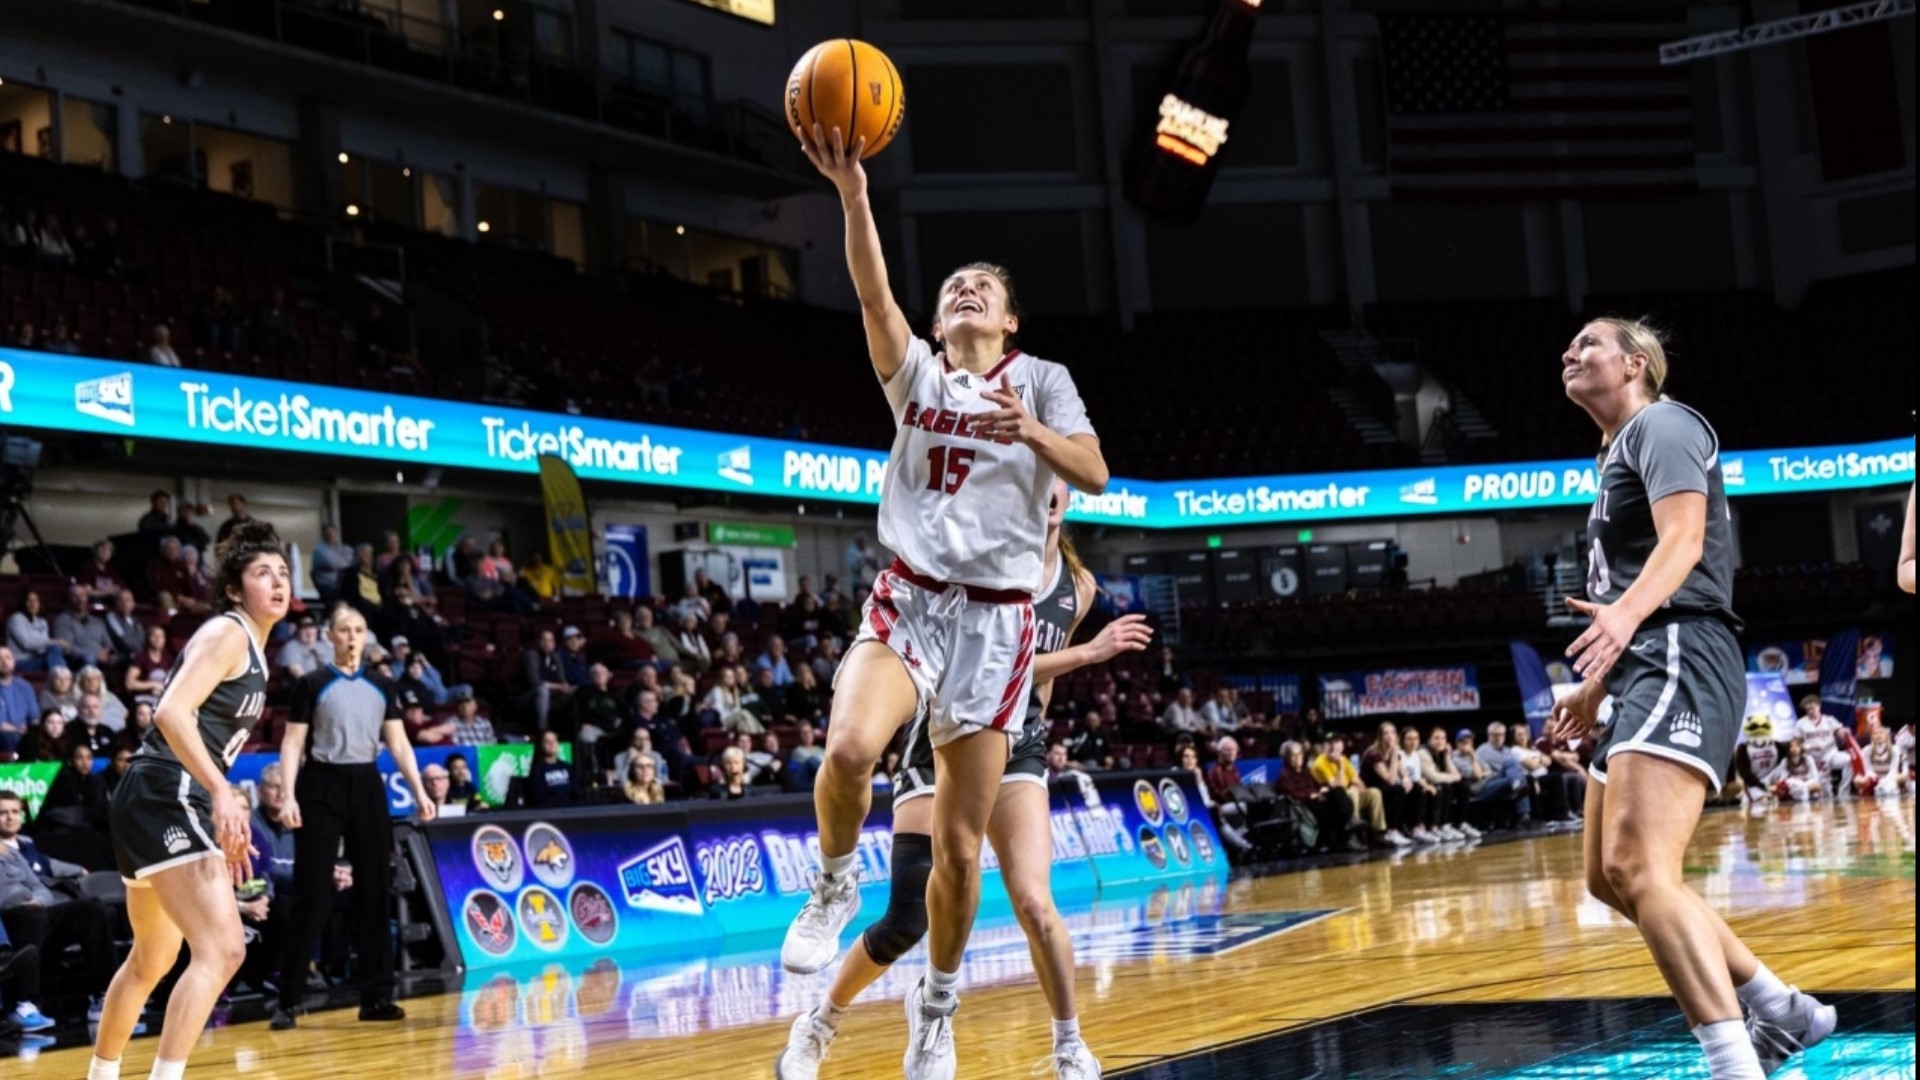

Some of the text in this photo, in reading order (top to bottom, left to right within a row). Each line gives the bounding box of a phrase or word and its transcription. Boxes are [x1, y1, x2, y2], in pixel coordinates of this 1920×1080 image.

[180, 382, 435, 451] TicketSmarter
[903, 401, 1014, 446] EAGL
[481, 416, 683, 476] TicketSmarter
[783, 449, 861, 494] PROUD
[926, 445, 976, 496] 15
[1463, 471, 1556, 502] PROUD
[1174, 481, 1371, 517] TicketSmarter
[624, 845, 688, 888] BIG SKY
[697, 839, 763, 906] 2023
